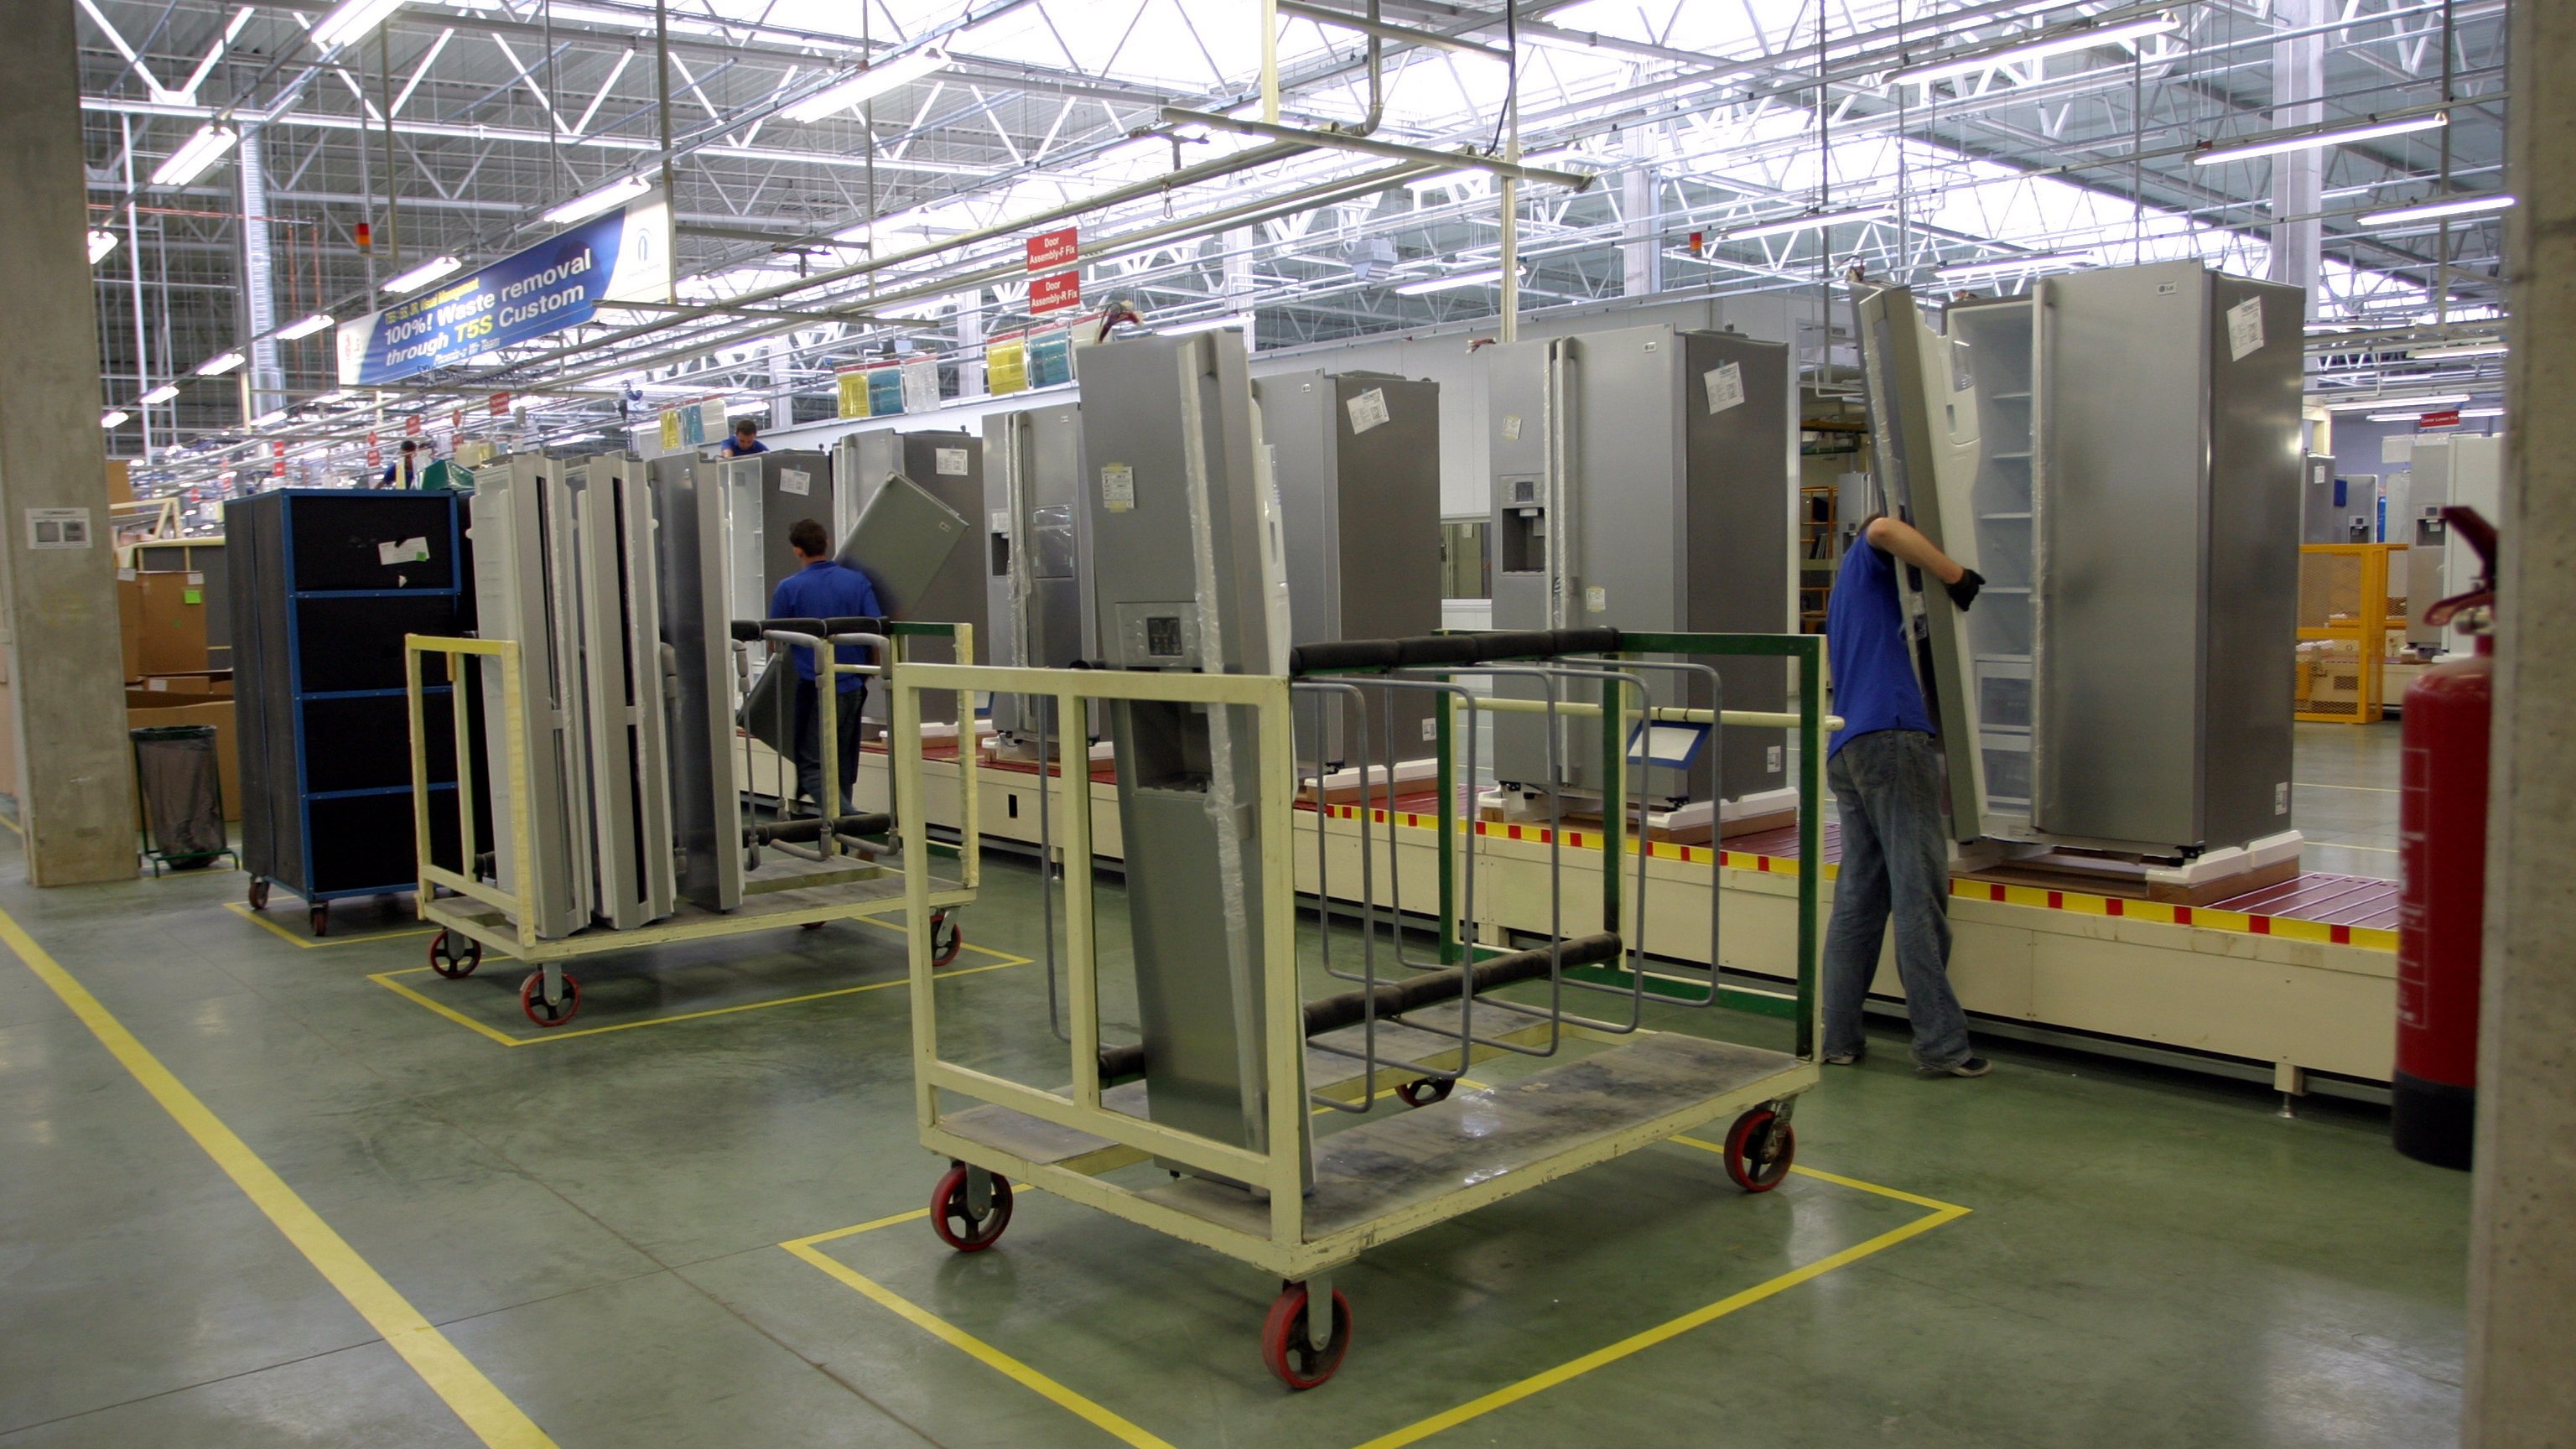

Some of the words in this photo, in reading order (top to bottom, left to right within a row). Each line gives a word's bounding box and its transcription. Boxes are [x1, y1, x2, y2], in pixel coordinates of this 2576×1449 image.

[1044, 236, 1060, 248] Door
[1065, 244, 1076, 255] Fix
[1045, 280, 1062, 292] Door
[385, 314, 433, 345] 100%!
[437, 293, 496, 327] Waste
[501, 248, 591, 304] removal
[1067, 288, 1078, 299] Fix
[386, 332, 449, 366] through
[454, 314, 493, 343] T5S
[498, 283, 584, 329] Custom
